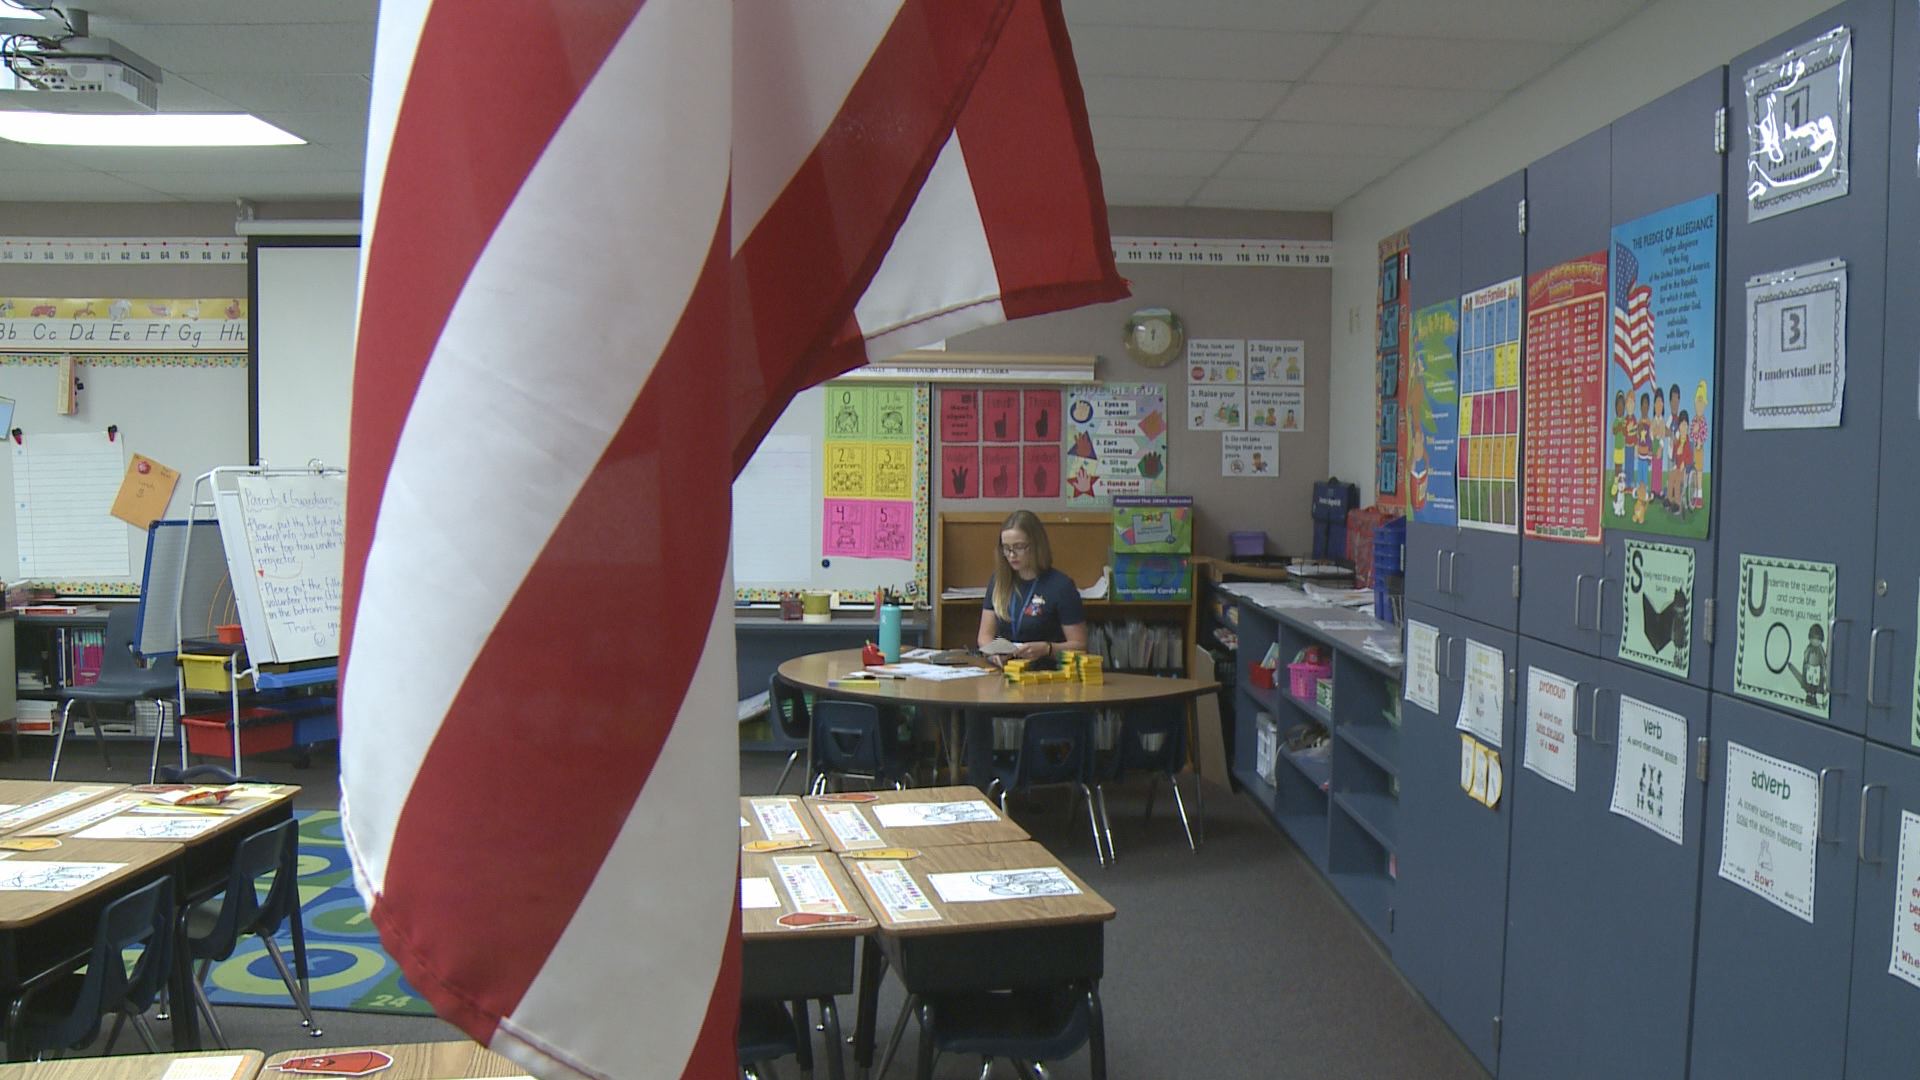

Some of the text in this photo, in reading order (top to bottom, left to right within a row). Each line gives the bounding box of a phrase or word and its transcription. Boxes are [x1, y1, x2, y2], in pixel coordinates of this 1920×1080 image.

[1792, 97, 1800, 128] 1
[1632, 215, 1714, 250] THE PLEDGE OF ALLEGIANCE
[121, 251, 130, 260] 62
[140, 251, 150, 260] 63
[160, 251, 170, 260] 64
[180, 250, 190, 260] 65
[202, 251, 211, 260] 66
[222, 251, 231, 260] 67
[1128, 251, 1330, 263] 111 112 113 114 115 116 117 118 119 120
[33, 323, 57, 341] Cc
[69, 323, 96, 341] Dd
[109, 323, 131, 342] Ee
[145, 324, 171, 341] Ff
[178, 324, 202, 348] Gg
[220, 324, 246, 341] Hh
[1789, 312, 1801, 345] 3
[1283, 346, 1298, 354] your
[1764, 364, 1816, 381] understand
[842, 391, 851, 405] 0
[1198, 390, 1218, 398] Raise
[1220, 391, 1235, 399] your
[1114, 420, 1128, 428] Lips
[838, 448, 844, 462] 2
[1104, 447, 1133, 455] Listening
[836, 505, 888, 523] 4 5
[1631, 550, 1643, 594] S
[1748, 567, 1768, 617] U
[1801, 583, 1828, 594] question
[1789, 595, 1805, 606] circle
[1770, 606, 1795, 618] numbers
[1540, 680, 1566, 700] pronoun
[1643, 717, 1663, 740] verb
[1751, 769, 1791, 801] adverb
[1760, 807, 1774, 822] word
[1774, 815, 1788, 829] that
[1758, 823, 1776, 838] action
[1777, 831, 1802, 851] happens
[1754, 869, 1775, 890] How?
